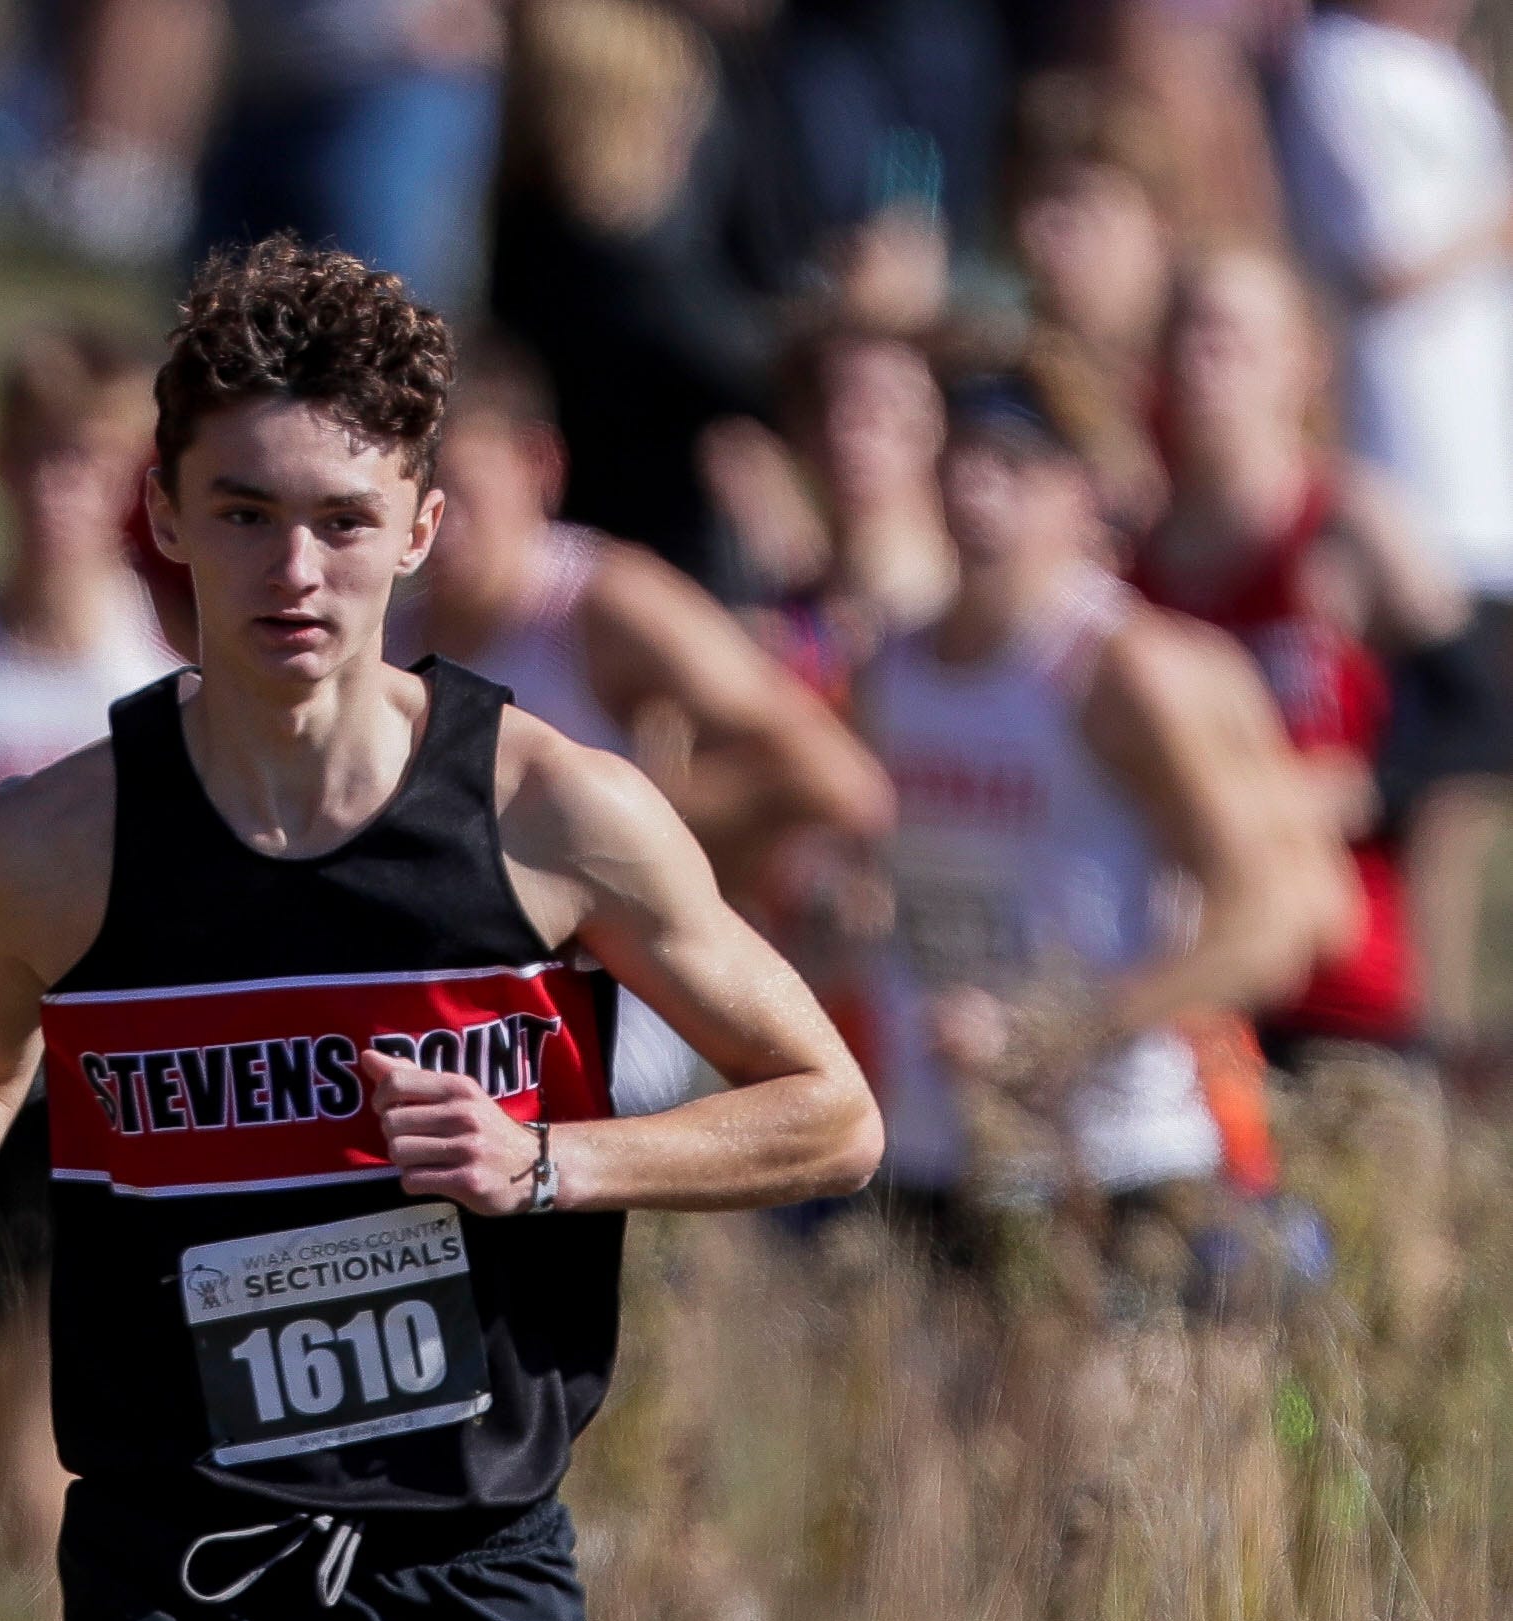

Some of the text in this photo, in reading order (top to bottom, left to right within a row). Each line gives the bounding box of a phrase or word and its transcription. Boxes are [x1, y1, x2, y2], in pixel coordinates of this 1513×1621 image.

[80, 1033, 363, 1137] STEVENS
[243, 1236, 462, 1299] SECTIONALS
[298, 1237, 361, 1261] CROSS
[231, 1300, 449, 1422] 1610
